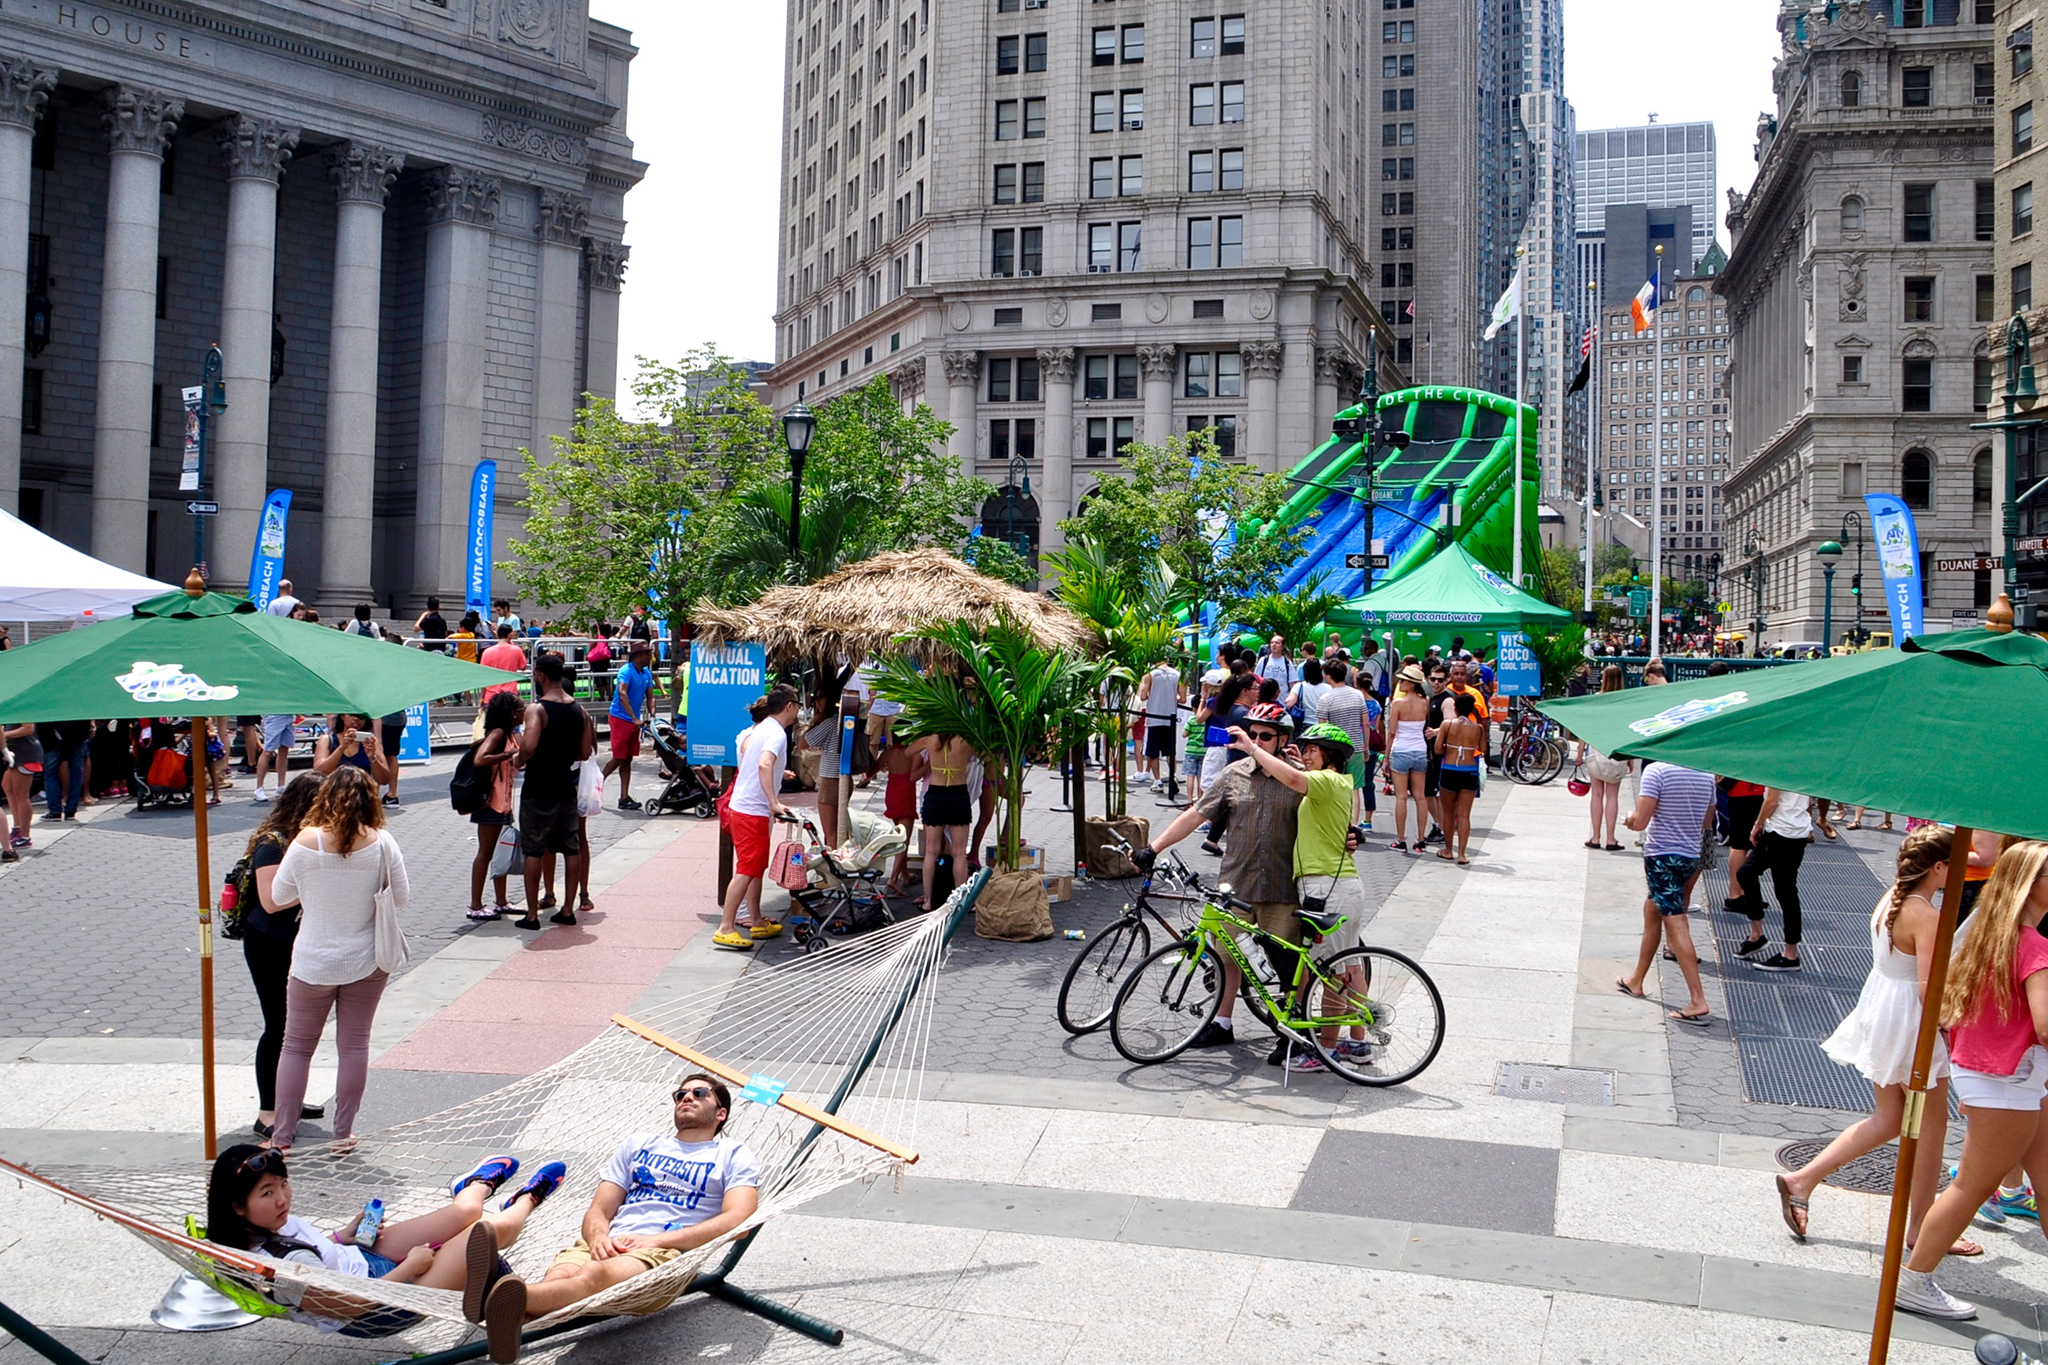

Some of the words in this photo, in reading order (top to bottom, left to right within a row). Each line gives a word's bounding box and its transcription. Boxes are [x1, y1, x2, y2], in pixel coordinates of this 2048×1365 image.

[58, 5, 190, 58] HOUSE
[1355, 391, 1404, 415] SIDE
[1413, 388, 1443, 400] THE
[1453, 389, 1497, 409] CITY
[1374, 490, 1393, 499] DUANE
[472, 473, 489, 593] #VITACOCOBEACH
[2016, 539, 2043, 551] LAFAYETTE
[1940, 560, 1979, 571] DUANE
[1985, 558, 1999, 569] ST
[1386, 611, 1411, 623] pure
[1412, 611, 1453, 622] coconut
[1453, 613, 1482, 622] water
[1501, 634, 1524, 647] VITA
[696, 647, 753, 665] VIRTUAL
[1500, 648, 1529, 661] COCO
[1500, 662, 1518, 670] COOL
[1520, 662, 1537, 670] SPOT
[695, 667, 760, 686] VACATION
[632, 1149, 716, 1192] UNIVERSITY
